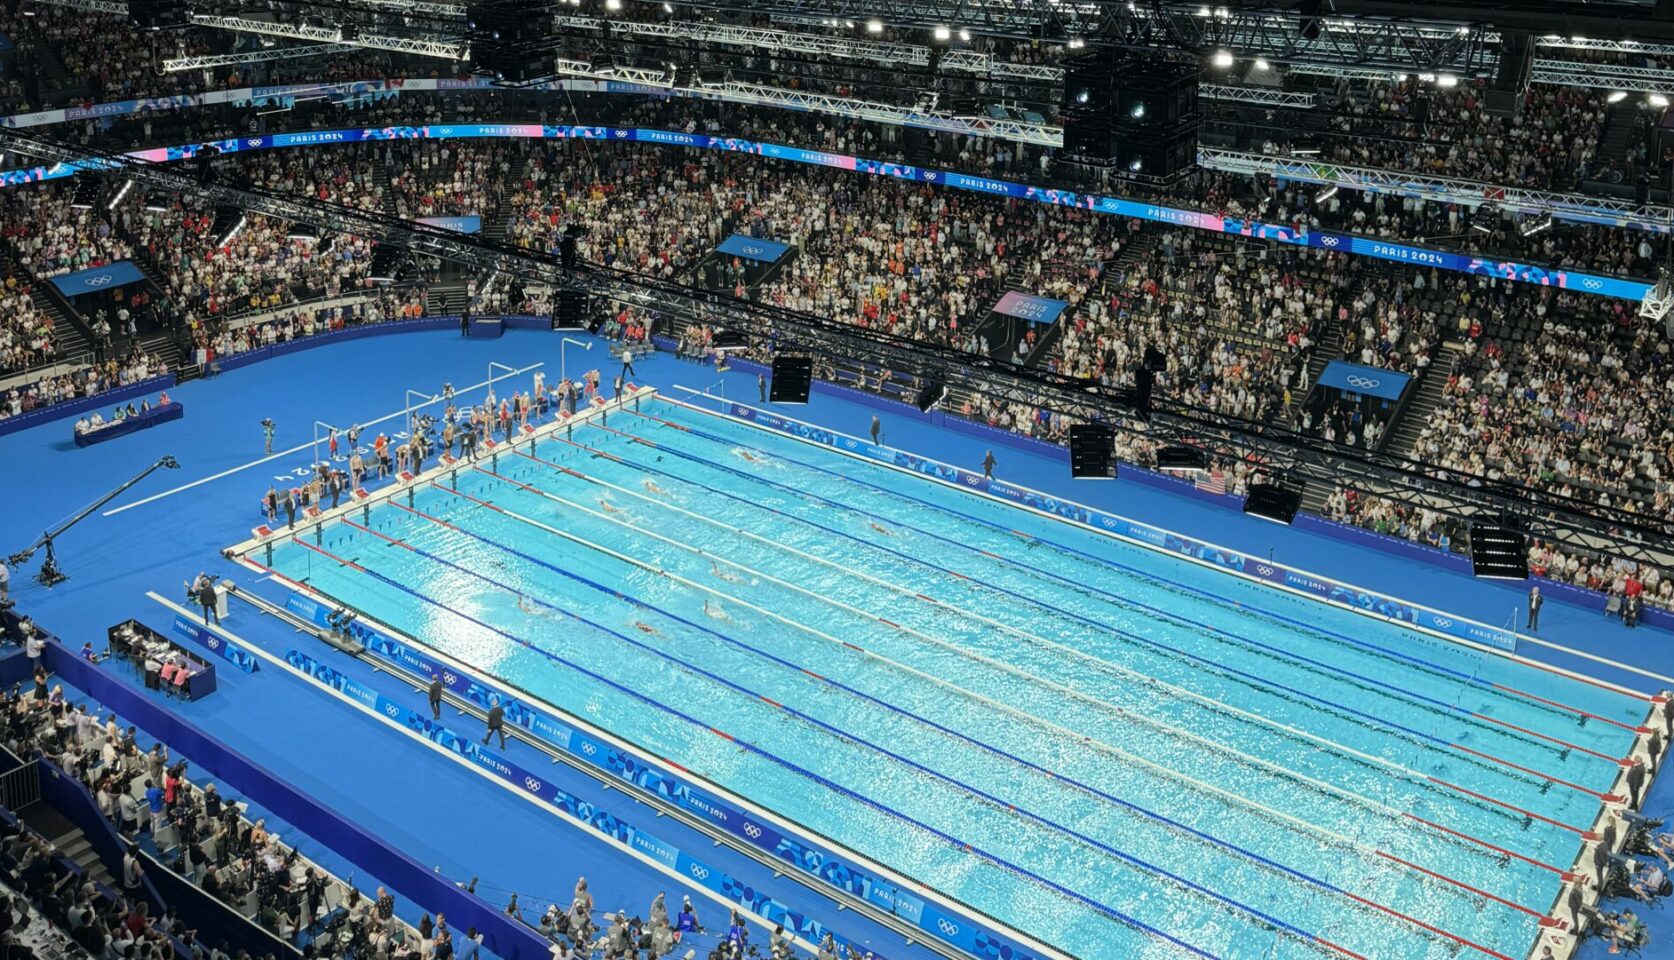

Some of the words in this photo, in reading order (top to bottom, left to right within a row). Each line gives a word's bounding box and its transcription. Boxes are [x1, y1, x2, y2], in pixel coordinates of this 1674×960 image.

[290, 134, 317, 143] PARIS
[319, 133, 343, 141] 2024
[651, 132, 673, 141] PARIS
[674, 135, 694, 143] 2024
[801, 152, 822, 161] PARIS
[823, 155, 843, 165] 2024
[960, 177, 984, 188] PARIS
[986, 182, 1008, 192] 2024
[1148, 208, 1177, 220] PARIS
[1179, 213, 1205, 224] 2024
[1374, 245, 1408, 258] PARIS
[1411, 251, 1443, 264] 2024
[1011, 307, 1043, 319] 2024
[1014, 300, 1048, 313] PARIS
[1288, 575, 1307, 586] PARIS
[1308, 580, 1326, 591] 2024
[1470, 628, 1491, 639] PARIS
[404, 655, 419, 666] PARIS
[480, 754, 496, 767] PARIS
[496, 763, 511, 776] 2024
[690, 797, 709, 811] PARIS
[710, 807, 727, 820] 2024
[636, 837, 655, 851] PARIS
[656, 847, 674, 861] 2024
[897, 899, 918, 914] 2024
